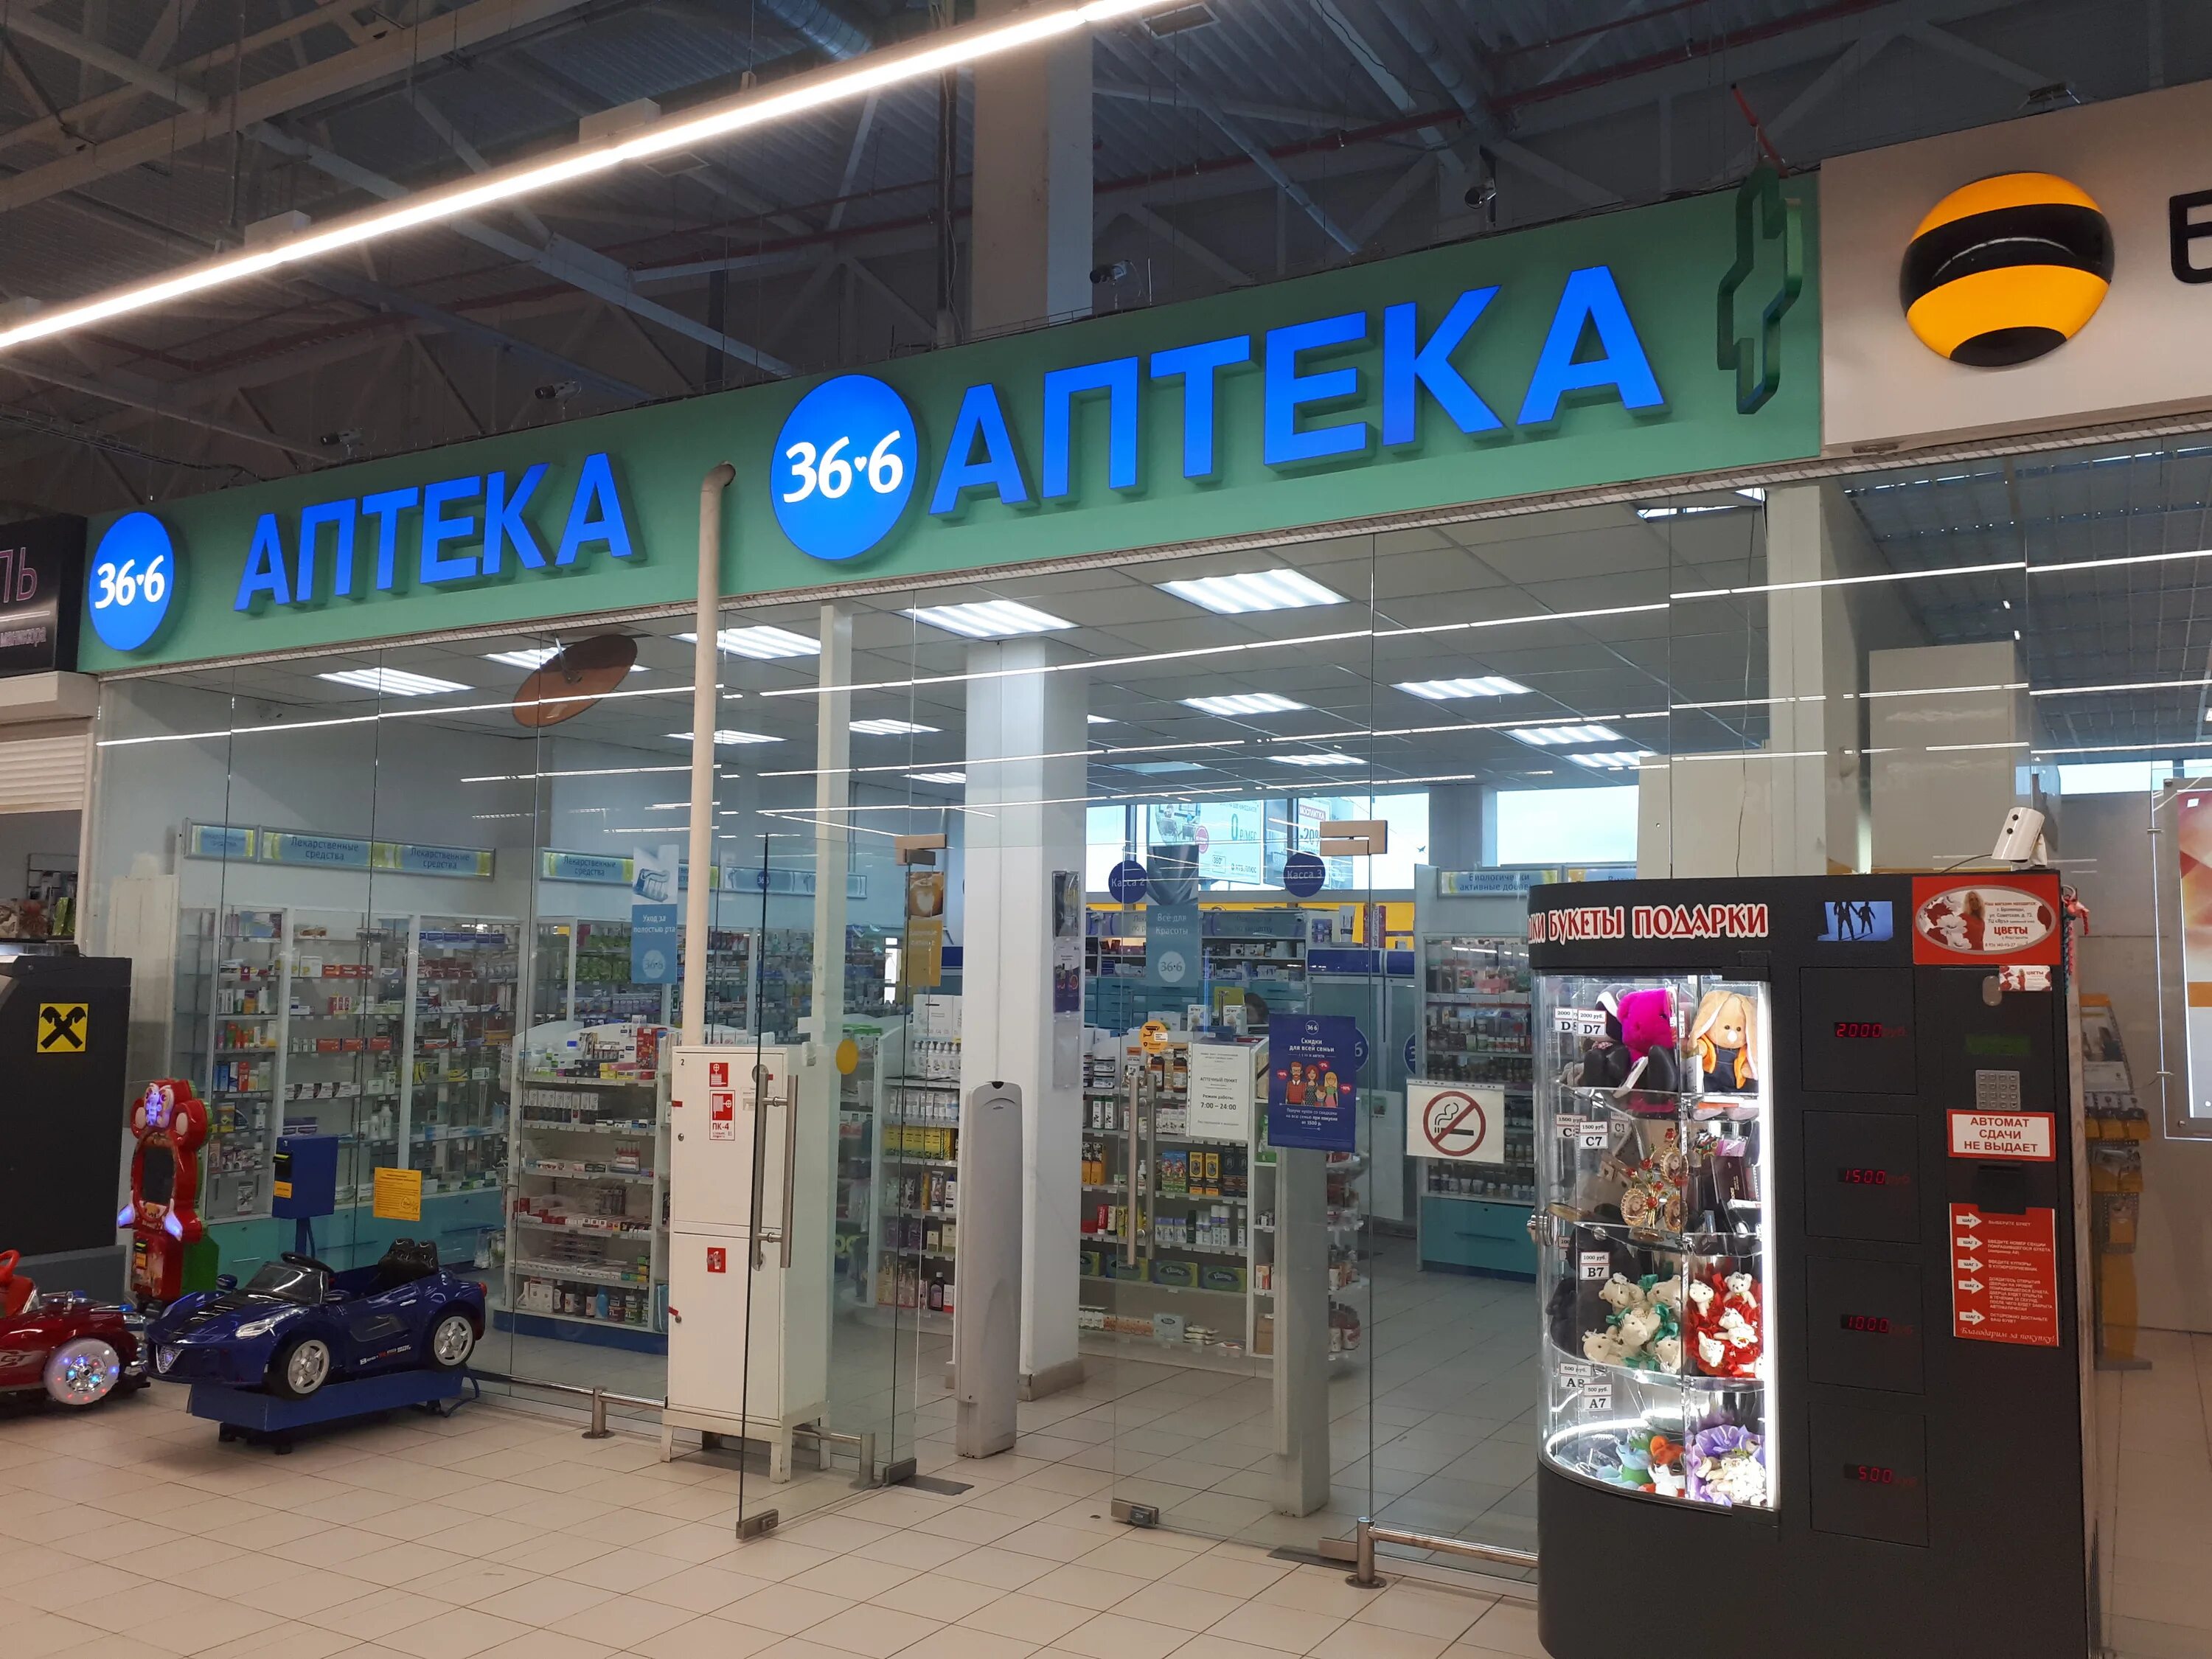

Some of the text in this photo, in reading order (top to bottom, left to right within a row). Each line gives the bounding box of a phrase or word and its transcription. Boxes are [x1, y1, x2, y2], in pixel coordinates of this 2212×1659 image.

[929, 264, 1665, 515] АПТЕКА
[234, 452, 632, 612] АПТЕКА
[291, 837, 358, 852] Лекарственные
[305, 849, 344, 860] средства
[410, 848, 470, 860] Лекарственные
[423, 860, 456, 869] средства
[563, 856, 616, 868] Лекарственные
[574, 868, 605, 877] средства
[1287, 869, 1322, 880] Касса 3
[1112, 878, 1145, 887] Касса 2
[1460, 883, 1500, 891] активные
[642, 914, 658, 922] Уход
[1172, 914, 1186, 922] для
[1549, 908, 1623, 943] БУКЕТЫ
[1632, 905, 1767, 939] ПОДАРКИ
[665, 926, 675, 934] рта
[1155, 926, 1189, 935] Красоты
[1994, 926, 2028, 936] ЦВЕТЫ
[1583, 1024, 1601, 1034] D7
[1837, 1023, 1882, 1037] 2000
[1301, 1037, 1322, 1046] Скидки
[712, 1122, 729, 1130] ПК-4
[1970, 1117, 2029, 1127] АВТОМАТ
[1615, 1123, 1626, 1133] C1
[1979, 1130, 2021, 1139] СДАЧИ
[1586, 1136, 1602, 1146] C7
[1964, 1141, 2037, 1152] НЕ ВЫДАЕТ
[1845, 1169, 1885, 1184] 1500
[1587, 1267, 1604, 1277] B7
[1848, 1317, 1889, 1333] 1000
[1961, 1327, 2007, 1338] Благодарим
[1589, 1398, 1606, 1409] A7
[1858, 1466, 1893, 1483] 500
